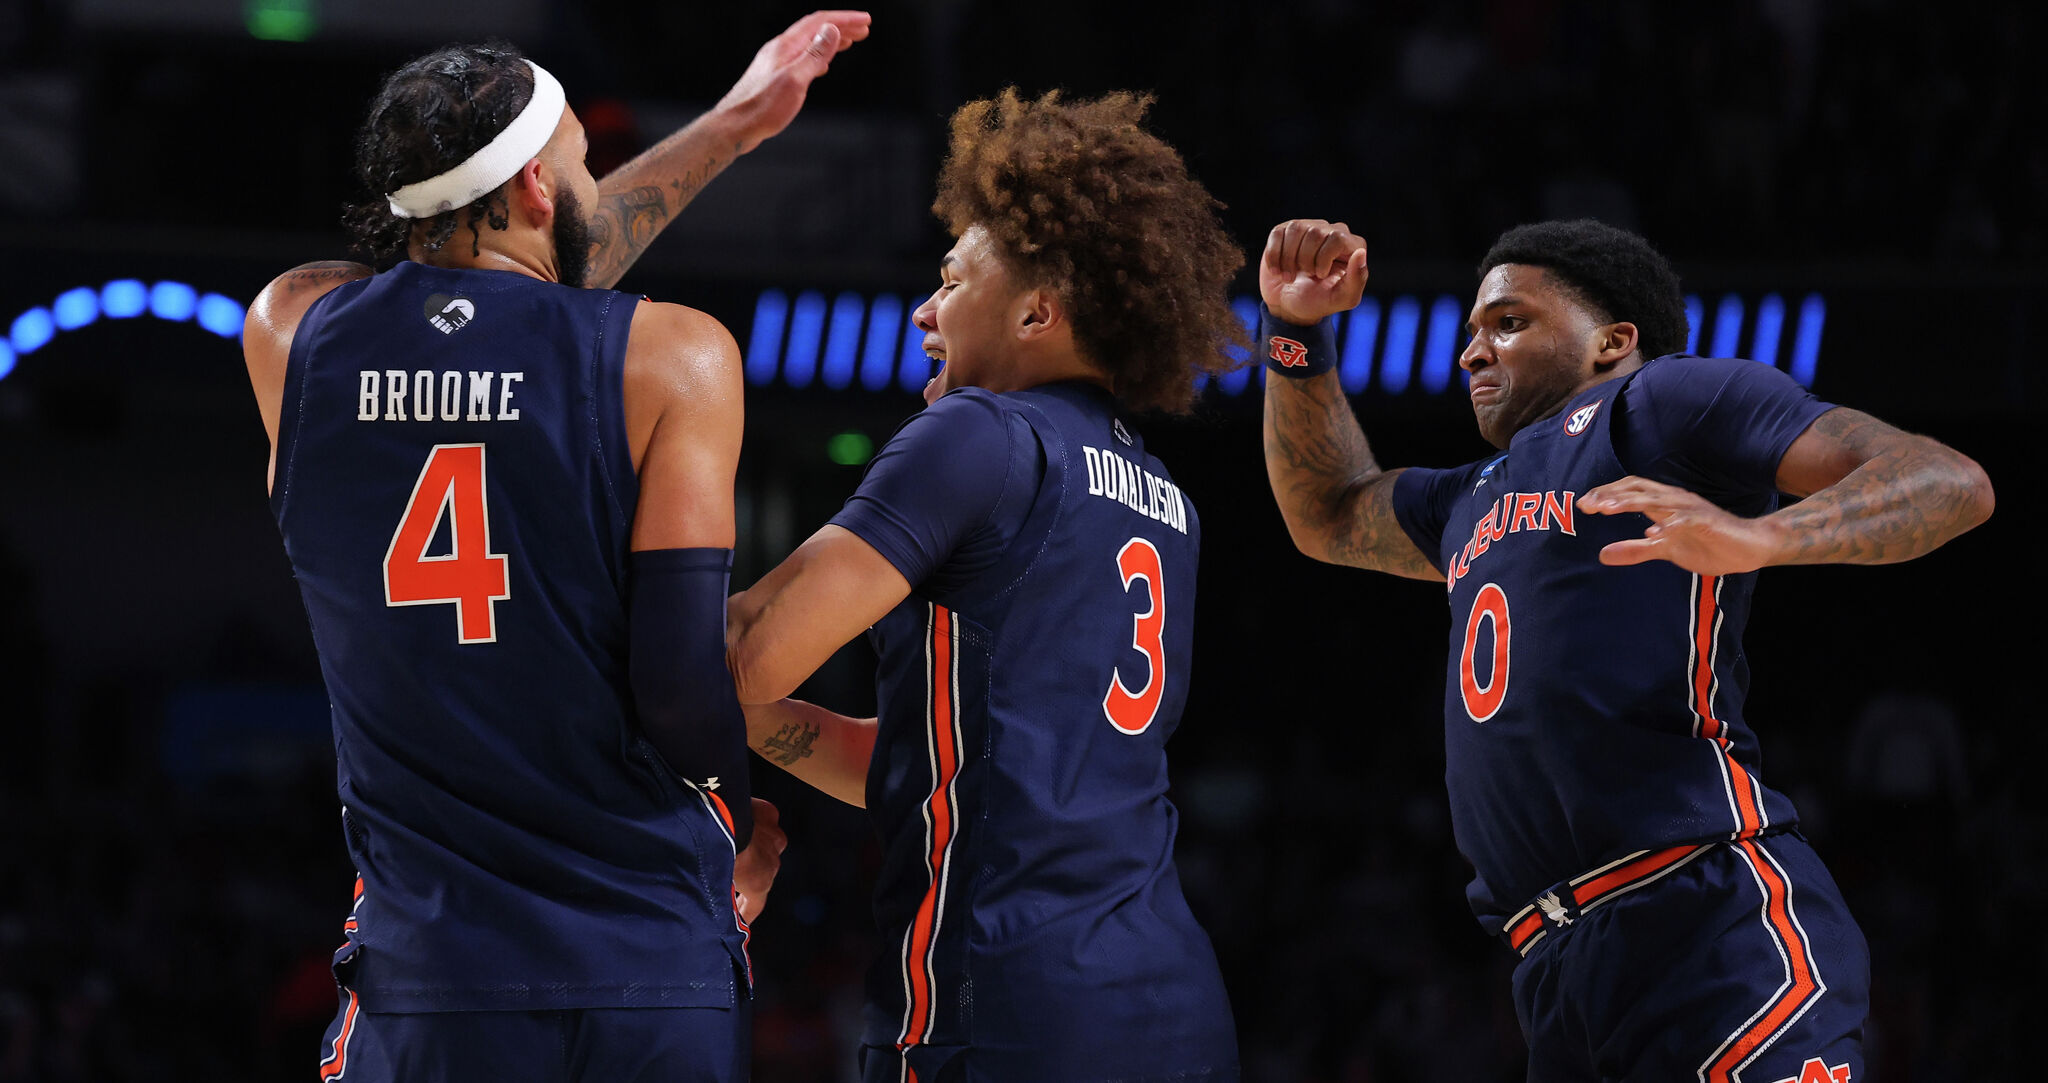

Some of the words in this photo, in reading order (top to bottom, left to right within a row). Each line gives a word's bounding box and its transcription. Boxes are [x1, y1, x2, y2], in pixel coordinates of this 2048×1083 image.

[358, 370, 524, 421] BROOME
[383, 443, 510, 643] 4
[1083, 446, 1187, 535] DONALDSON
[1102, 537, 1165, 735] 3
[1460, 583, 1511, 723] 0
